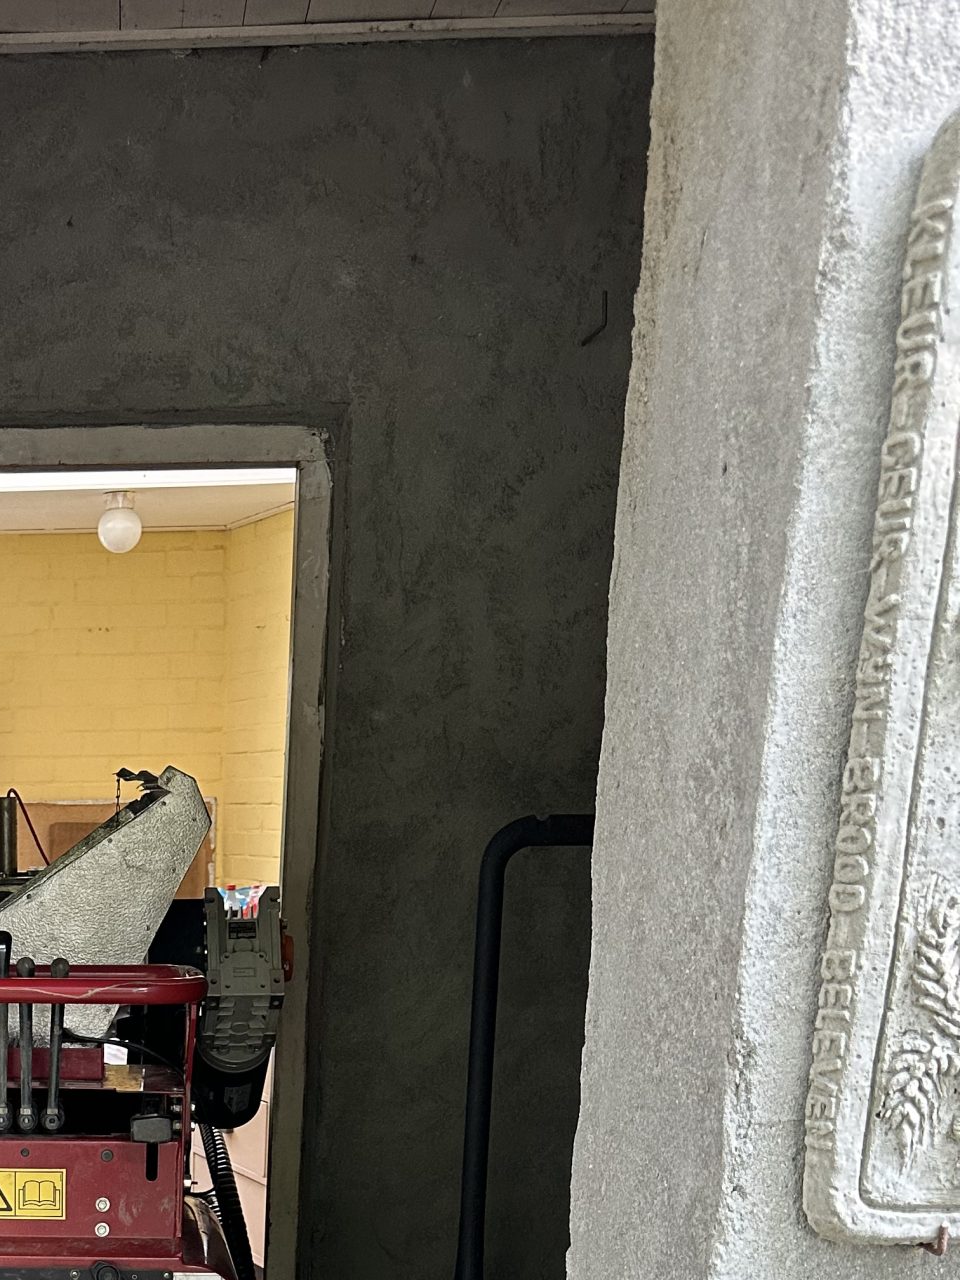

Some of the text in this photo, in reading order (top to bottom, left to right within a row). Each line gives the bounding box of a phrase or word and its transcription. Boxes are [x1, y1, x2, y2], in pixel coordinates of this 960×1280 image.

[892, 199, 952, 396] KLEUR
[828, 756, 880, 912] BROOD
[804, 950, 856, 1149] BELEVEN
